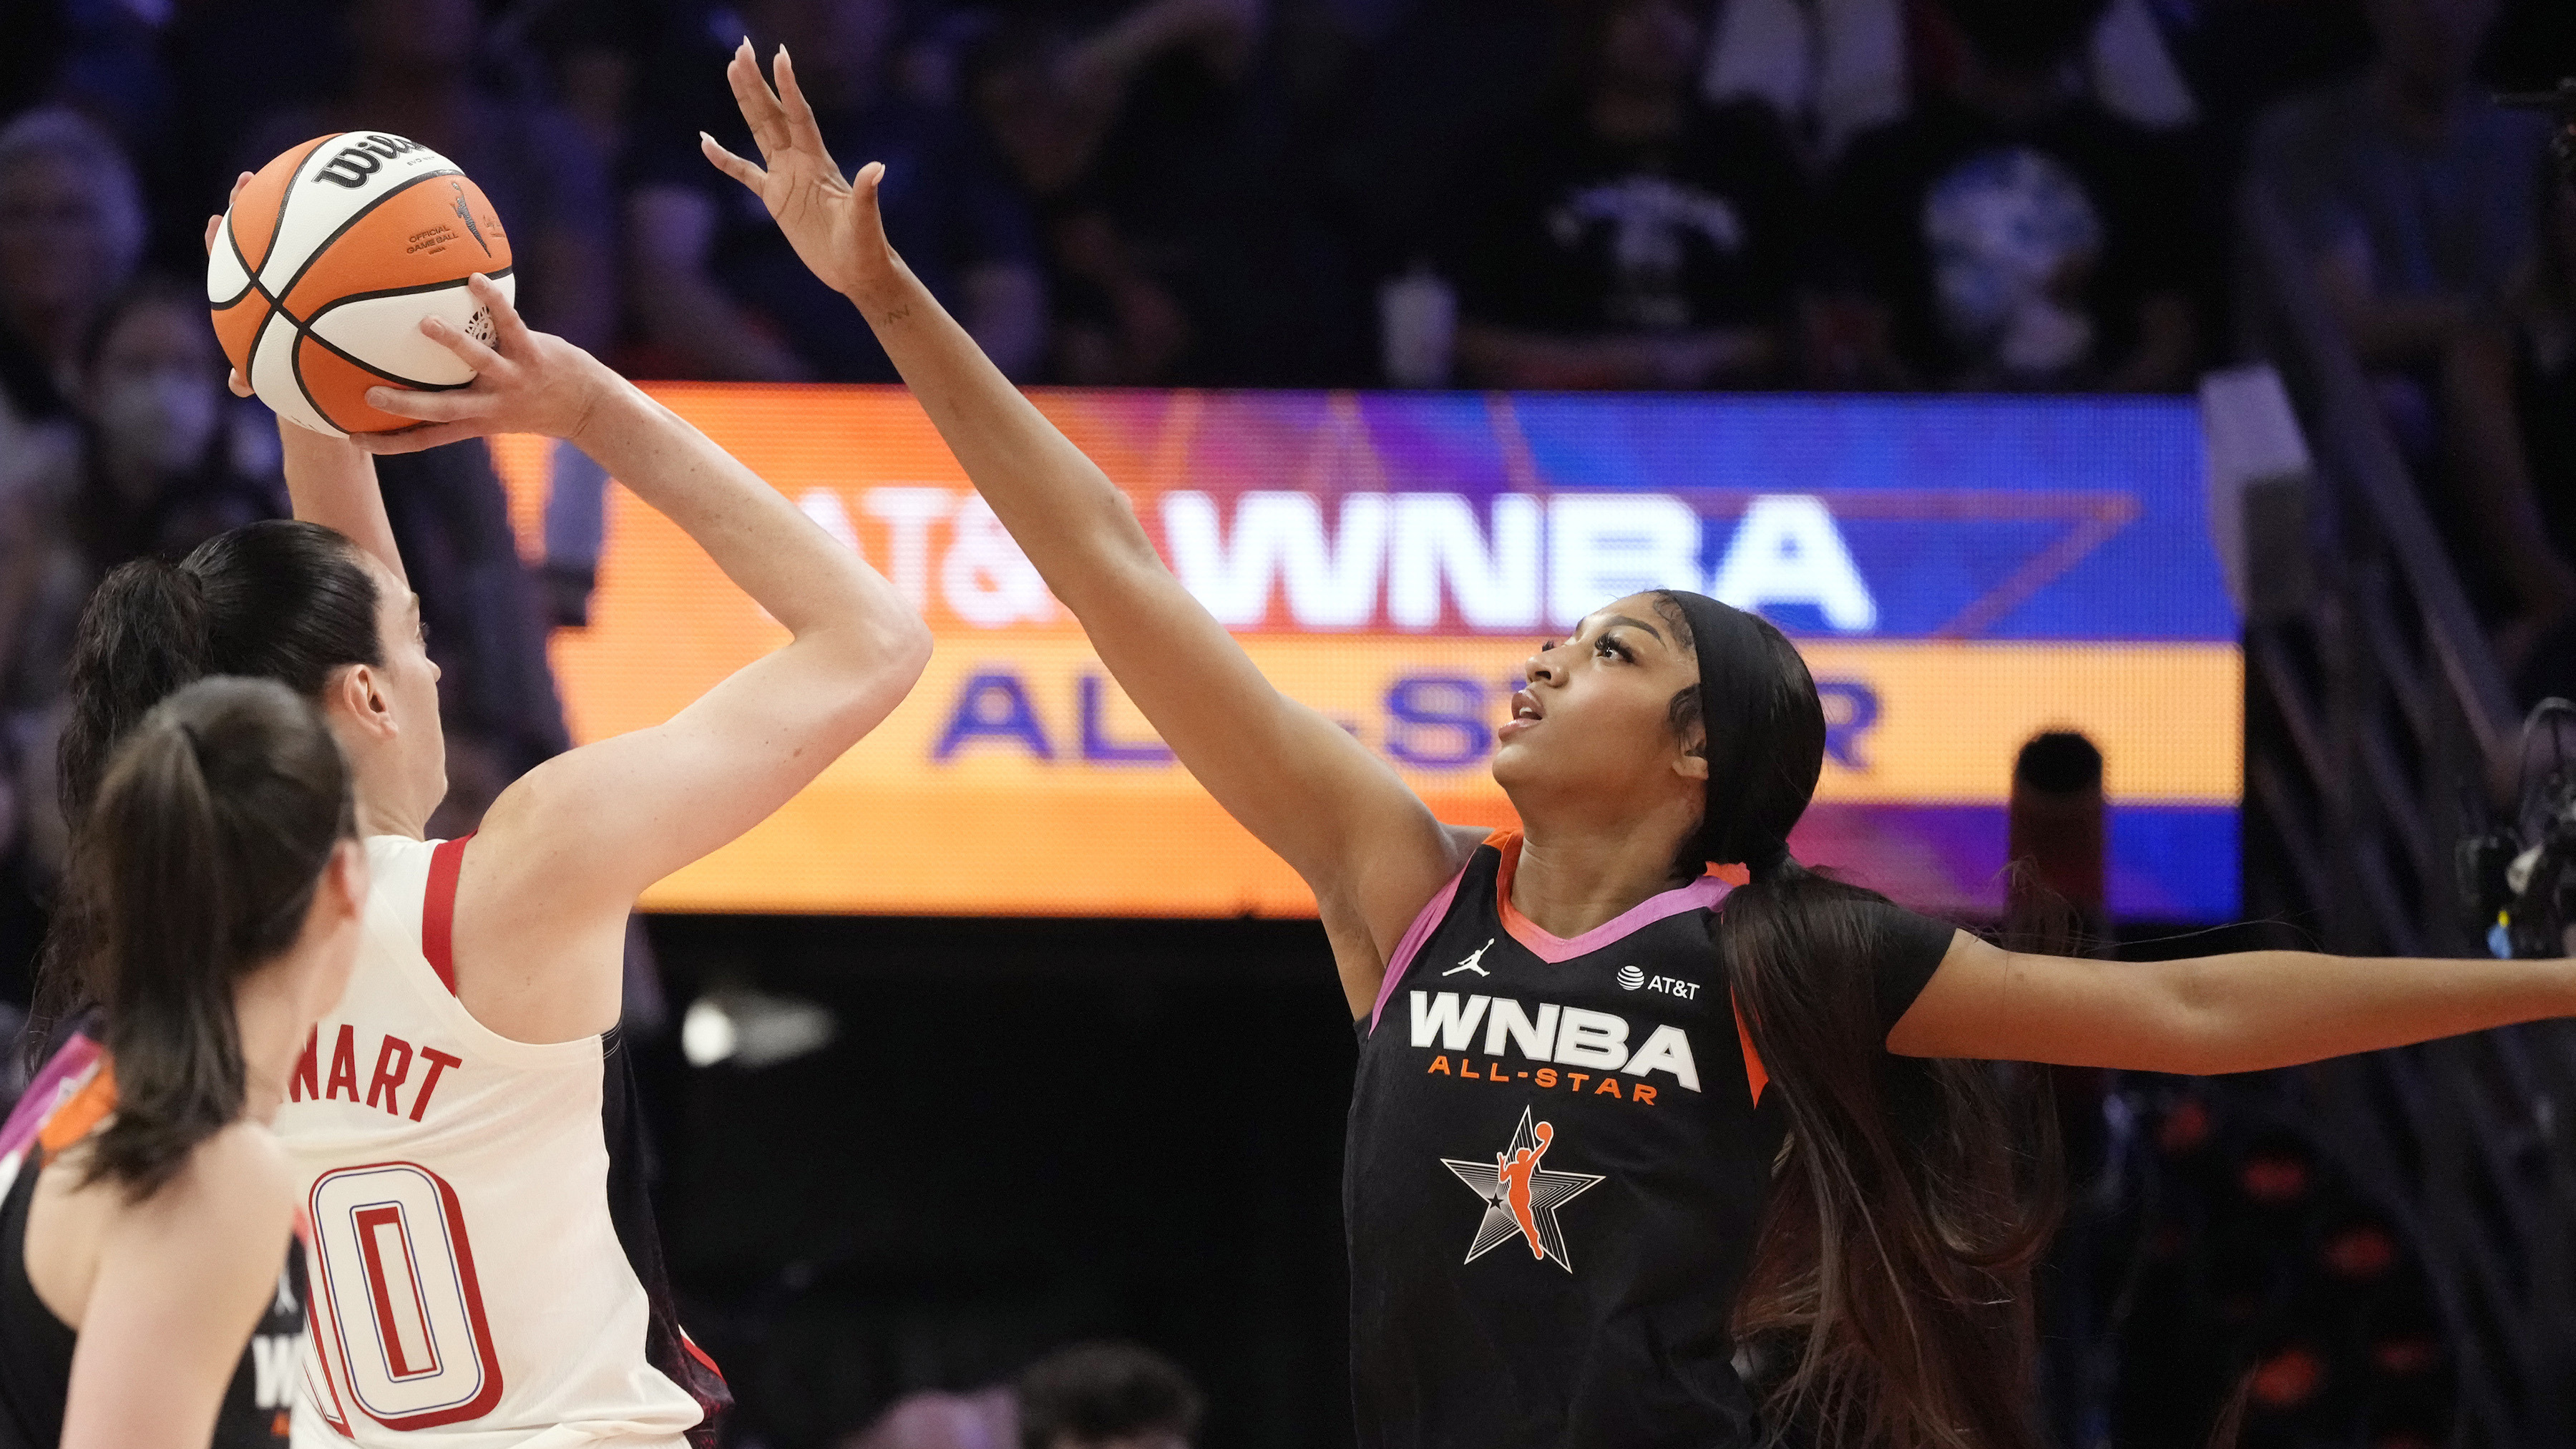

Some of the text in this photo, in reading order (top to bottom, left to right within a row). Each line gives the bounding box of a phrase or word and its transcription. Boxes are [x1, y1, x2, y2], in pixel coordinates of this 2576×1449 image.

[406, 238, 436, 254] GAME
[436, 232, 459, 244] BALL
[409, 225, 451, 243] OFFICIAL
[1161, 489, 1878, 633] WNBA
[1647, 975, 1700, 1000] AT&T
[1410, 990, 1702, 1093] WNBA
[1428, 1055, 1657, 1106] ALL-STAR
